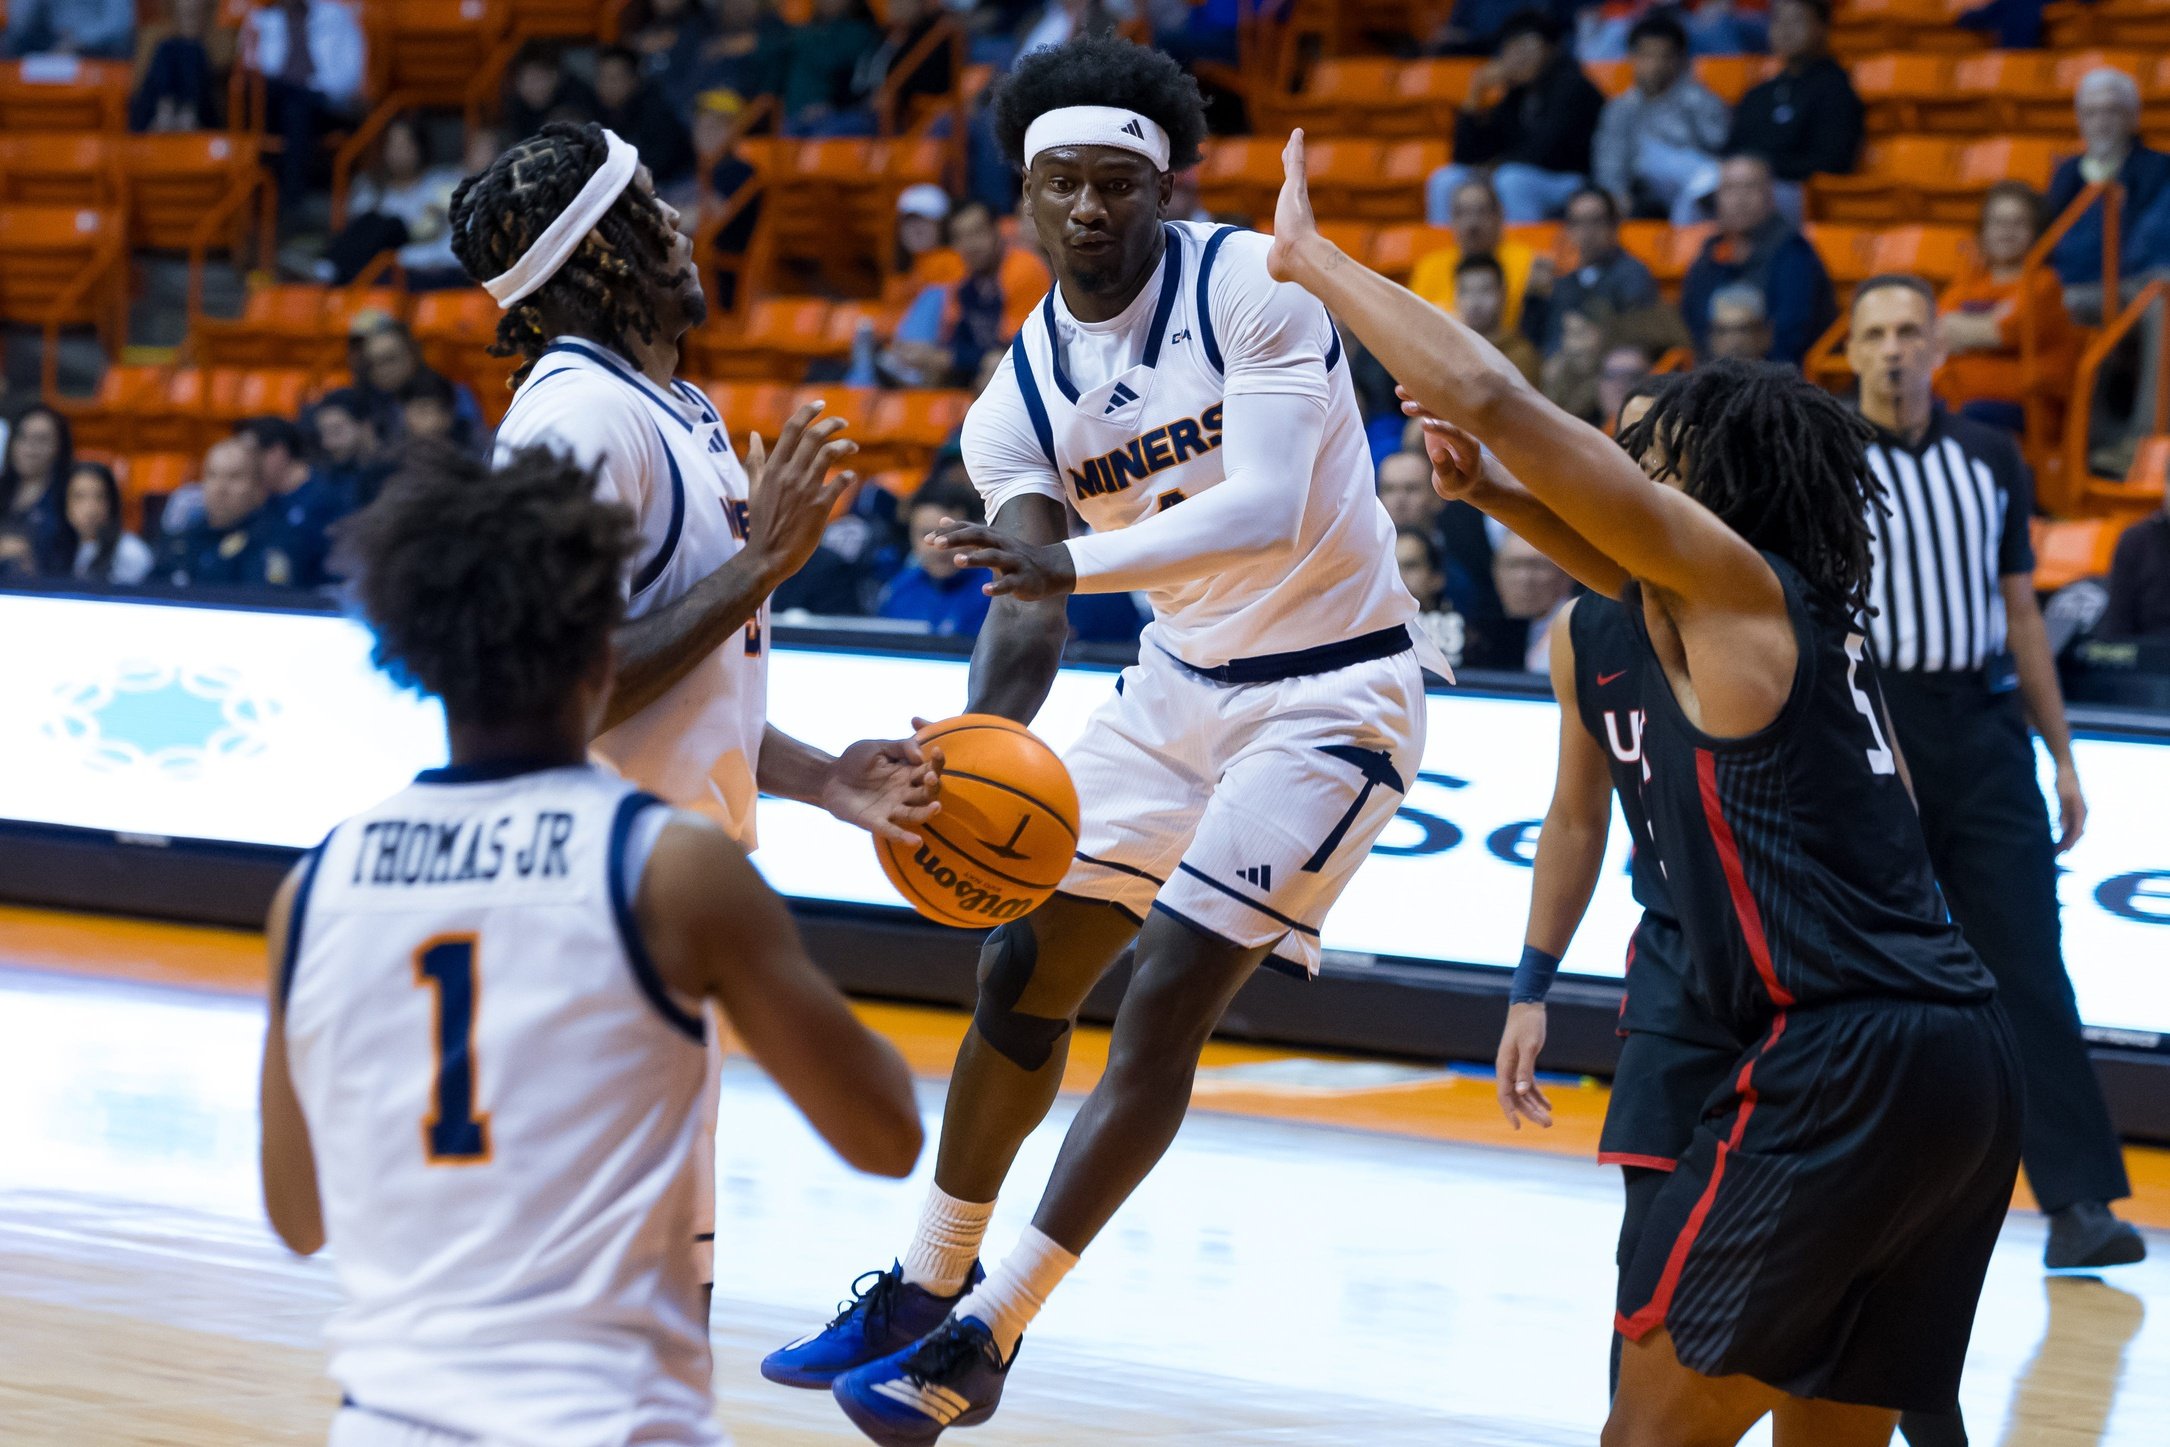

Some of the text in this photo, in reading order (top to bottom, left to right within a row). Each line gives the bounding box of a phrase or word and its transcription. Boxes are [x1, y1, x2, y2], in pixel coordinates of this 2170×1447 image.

[1067, 401, 1222, 501] MINERS
[351, 811, 575, 884] THOMAS JR
[914, 843, 1032, 918] Wilson
[411, 929, 495, 1166] 1
